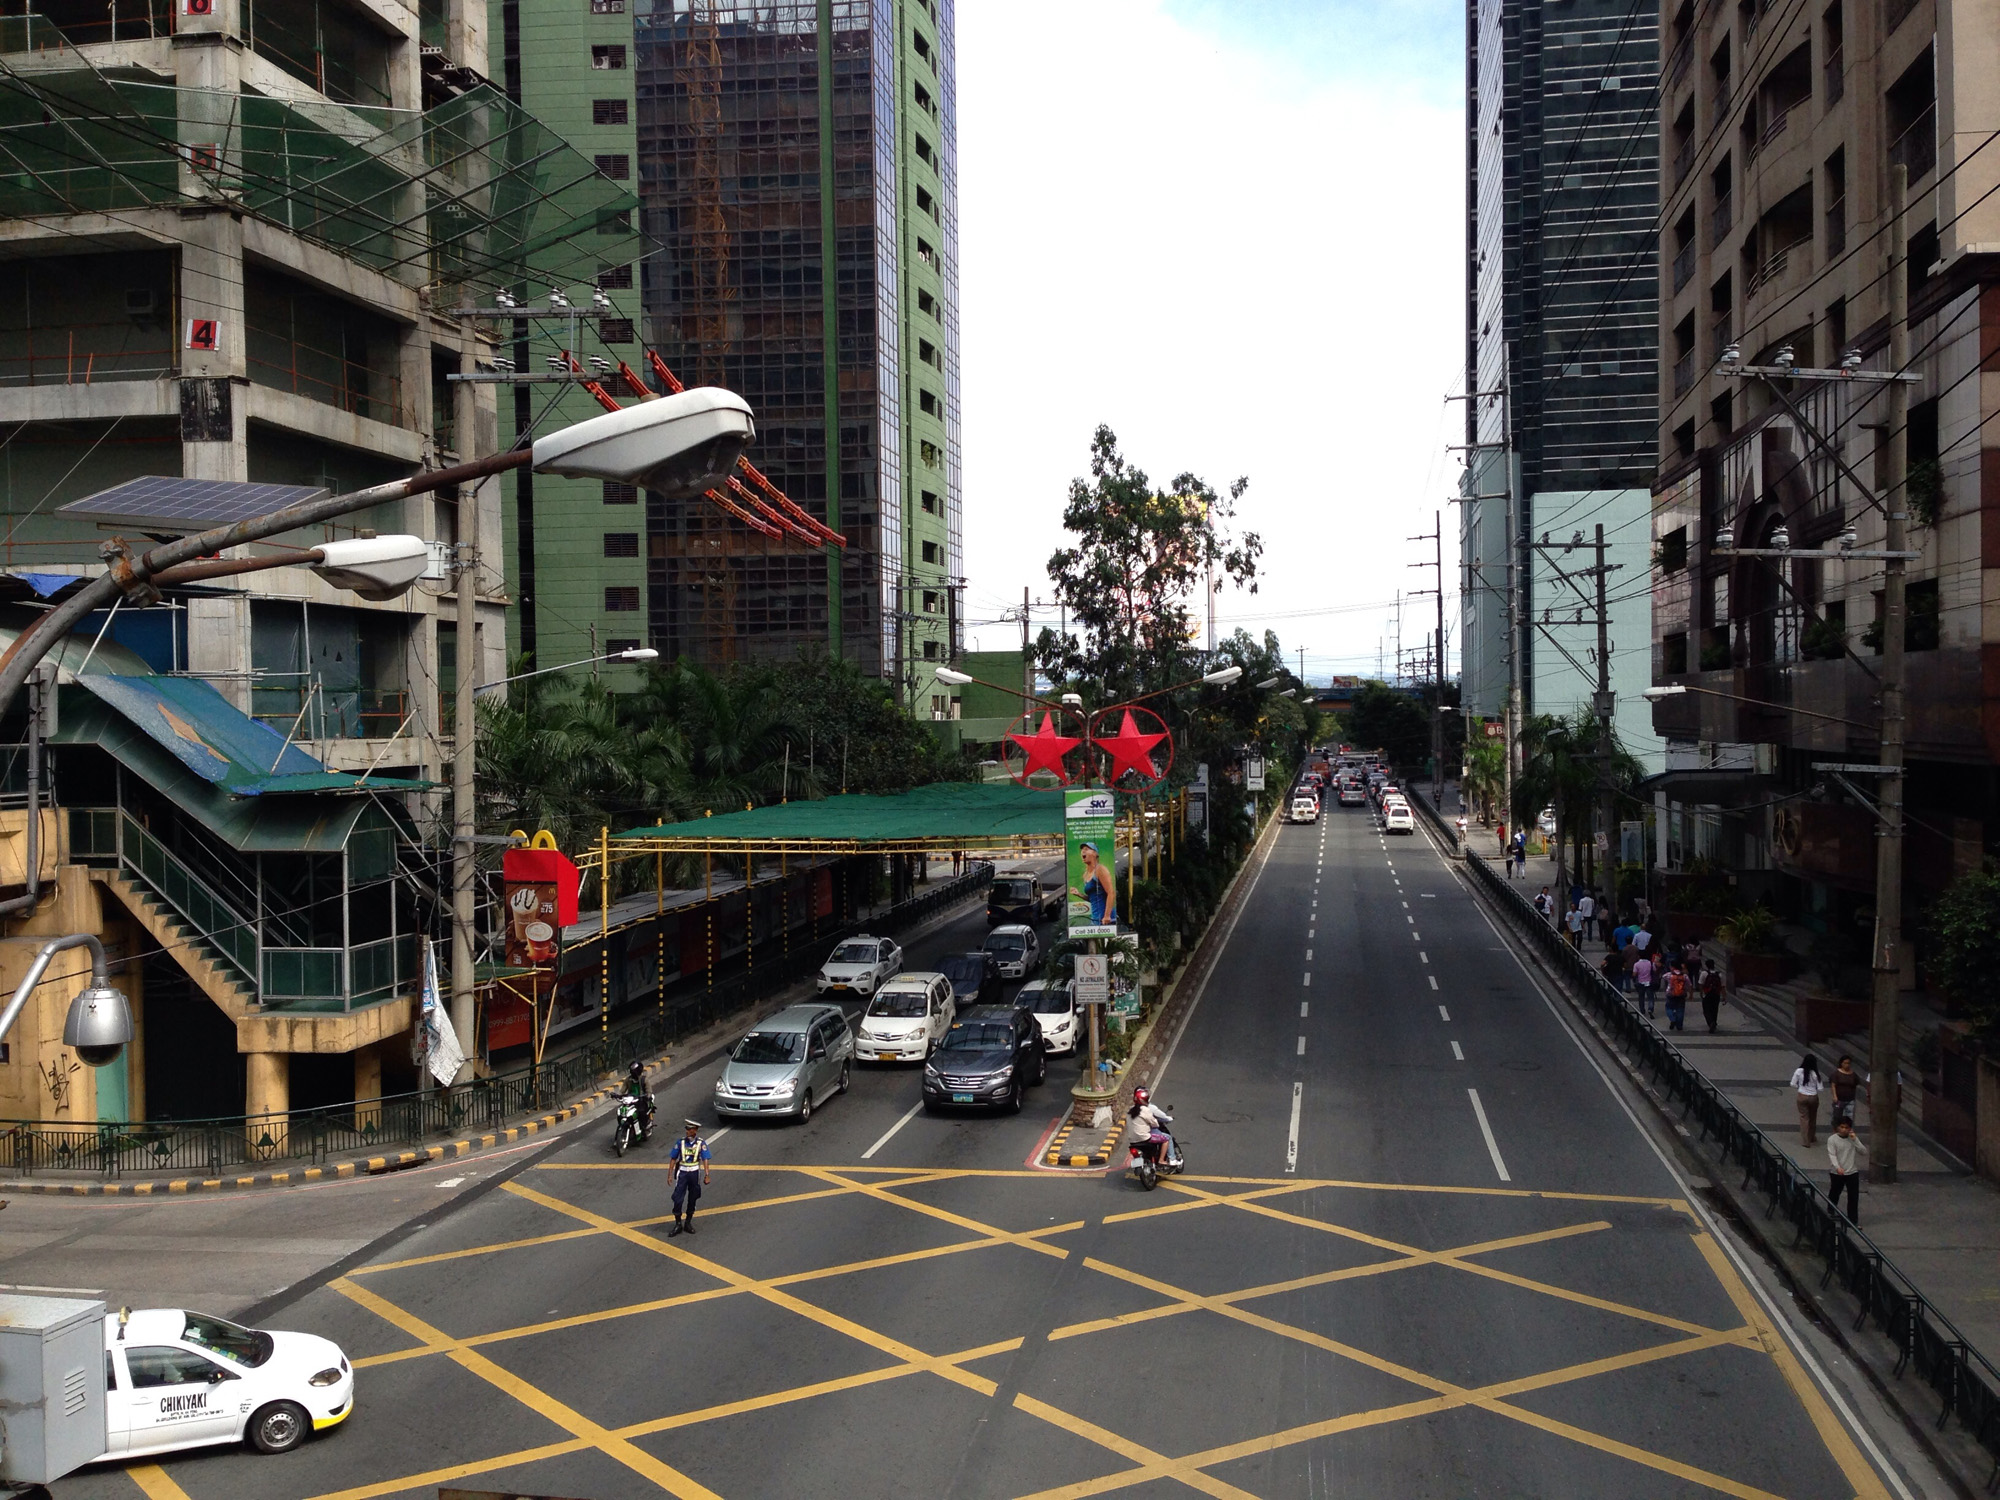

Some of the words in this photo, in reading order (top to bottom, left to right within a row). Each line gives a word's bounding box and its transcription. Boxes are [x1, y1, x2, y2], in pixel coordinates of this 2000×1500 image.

[193, 321, 213, 348] 4
[1090, 800, 1108, 808] SKY
[544, 904, 553, 914] 75
[160, 1392, 207, 1413] CHIKIYAKI
